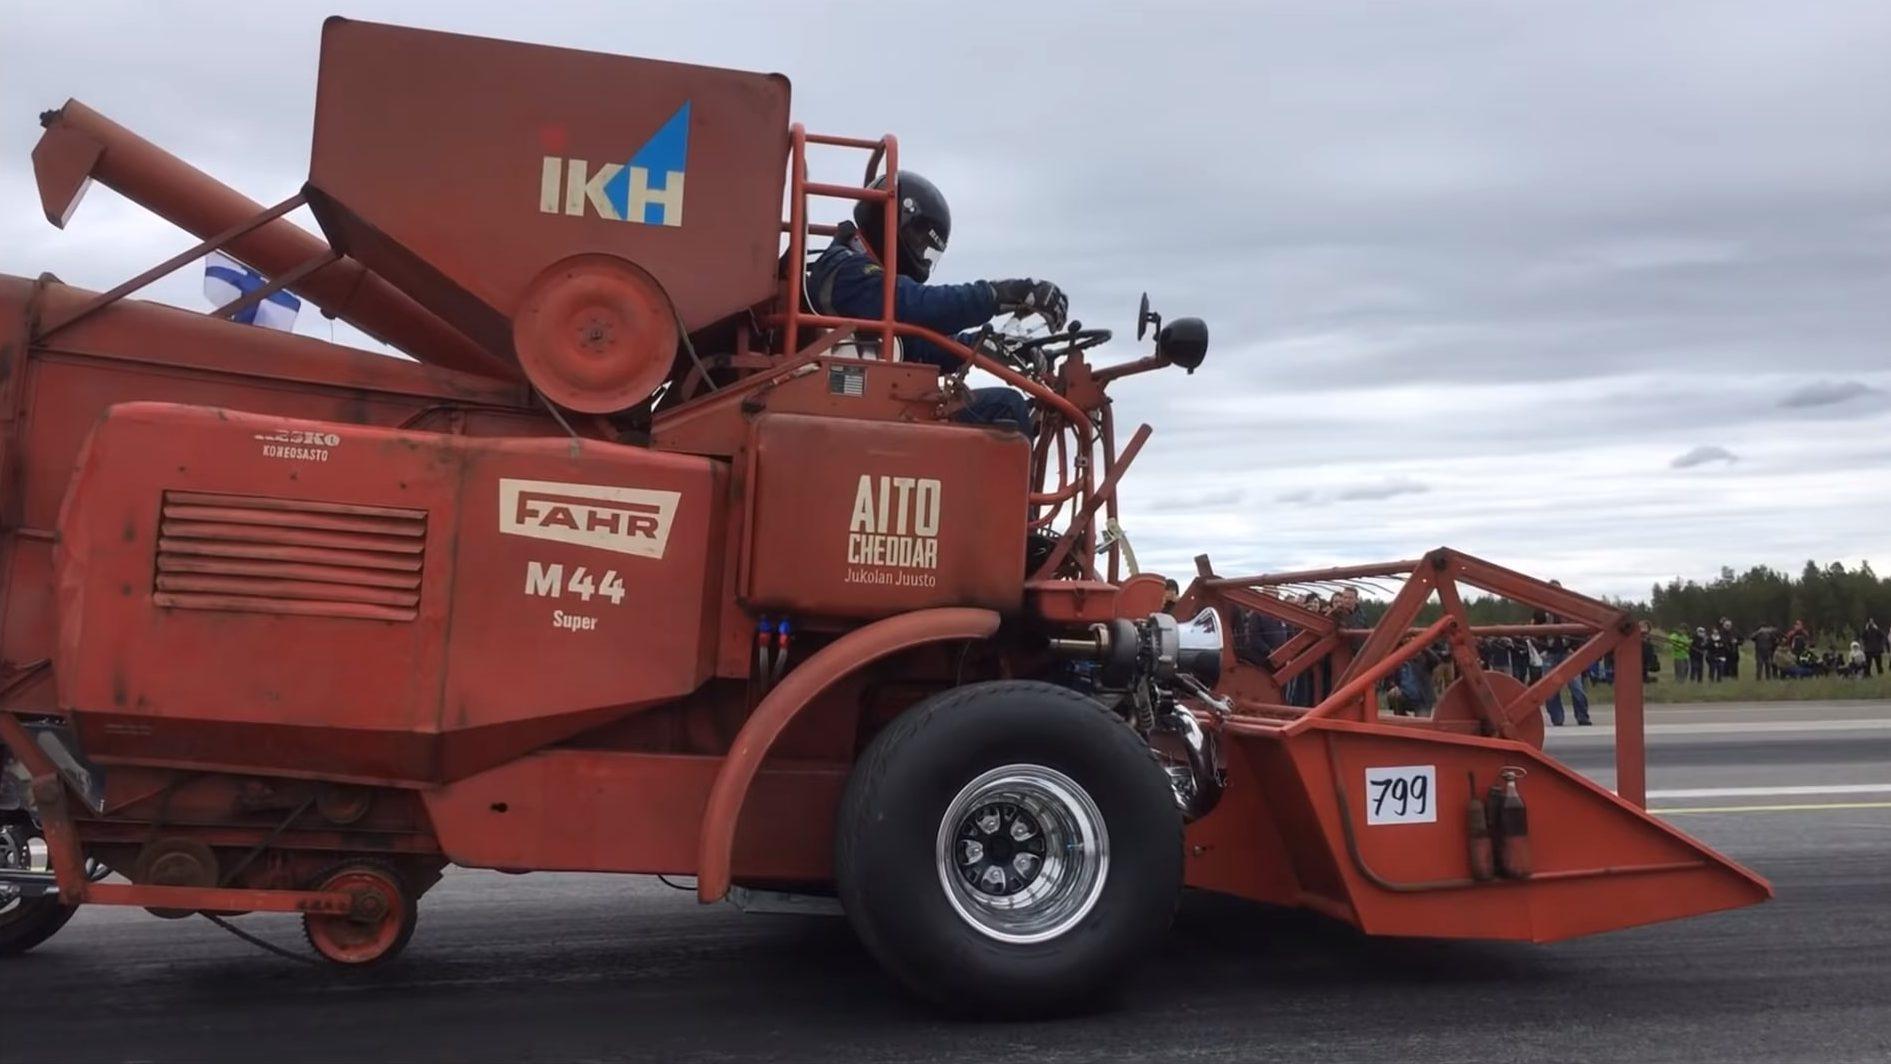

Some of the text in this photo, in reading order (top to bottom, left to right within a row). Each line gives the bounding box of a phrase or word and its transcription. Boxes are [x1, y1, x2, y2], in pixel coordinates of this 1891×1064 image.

[262, 445, 329, 462] KONEOSASTO
[515, 490, 661, 540] FAHR
[849, 474, 942, 537] AITO
[847, 533, 938, 570] CHEDDAR
[525, 561, 626, 605] M44
[844, 567, 936, 588] Jukolan Juusto
[553, 610, 598, 632] Super
[1369, 775, 1428, 816] 799
